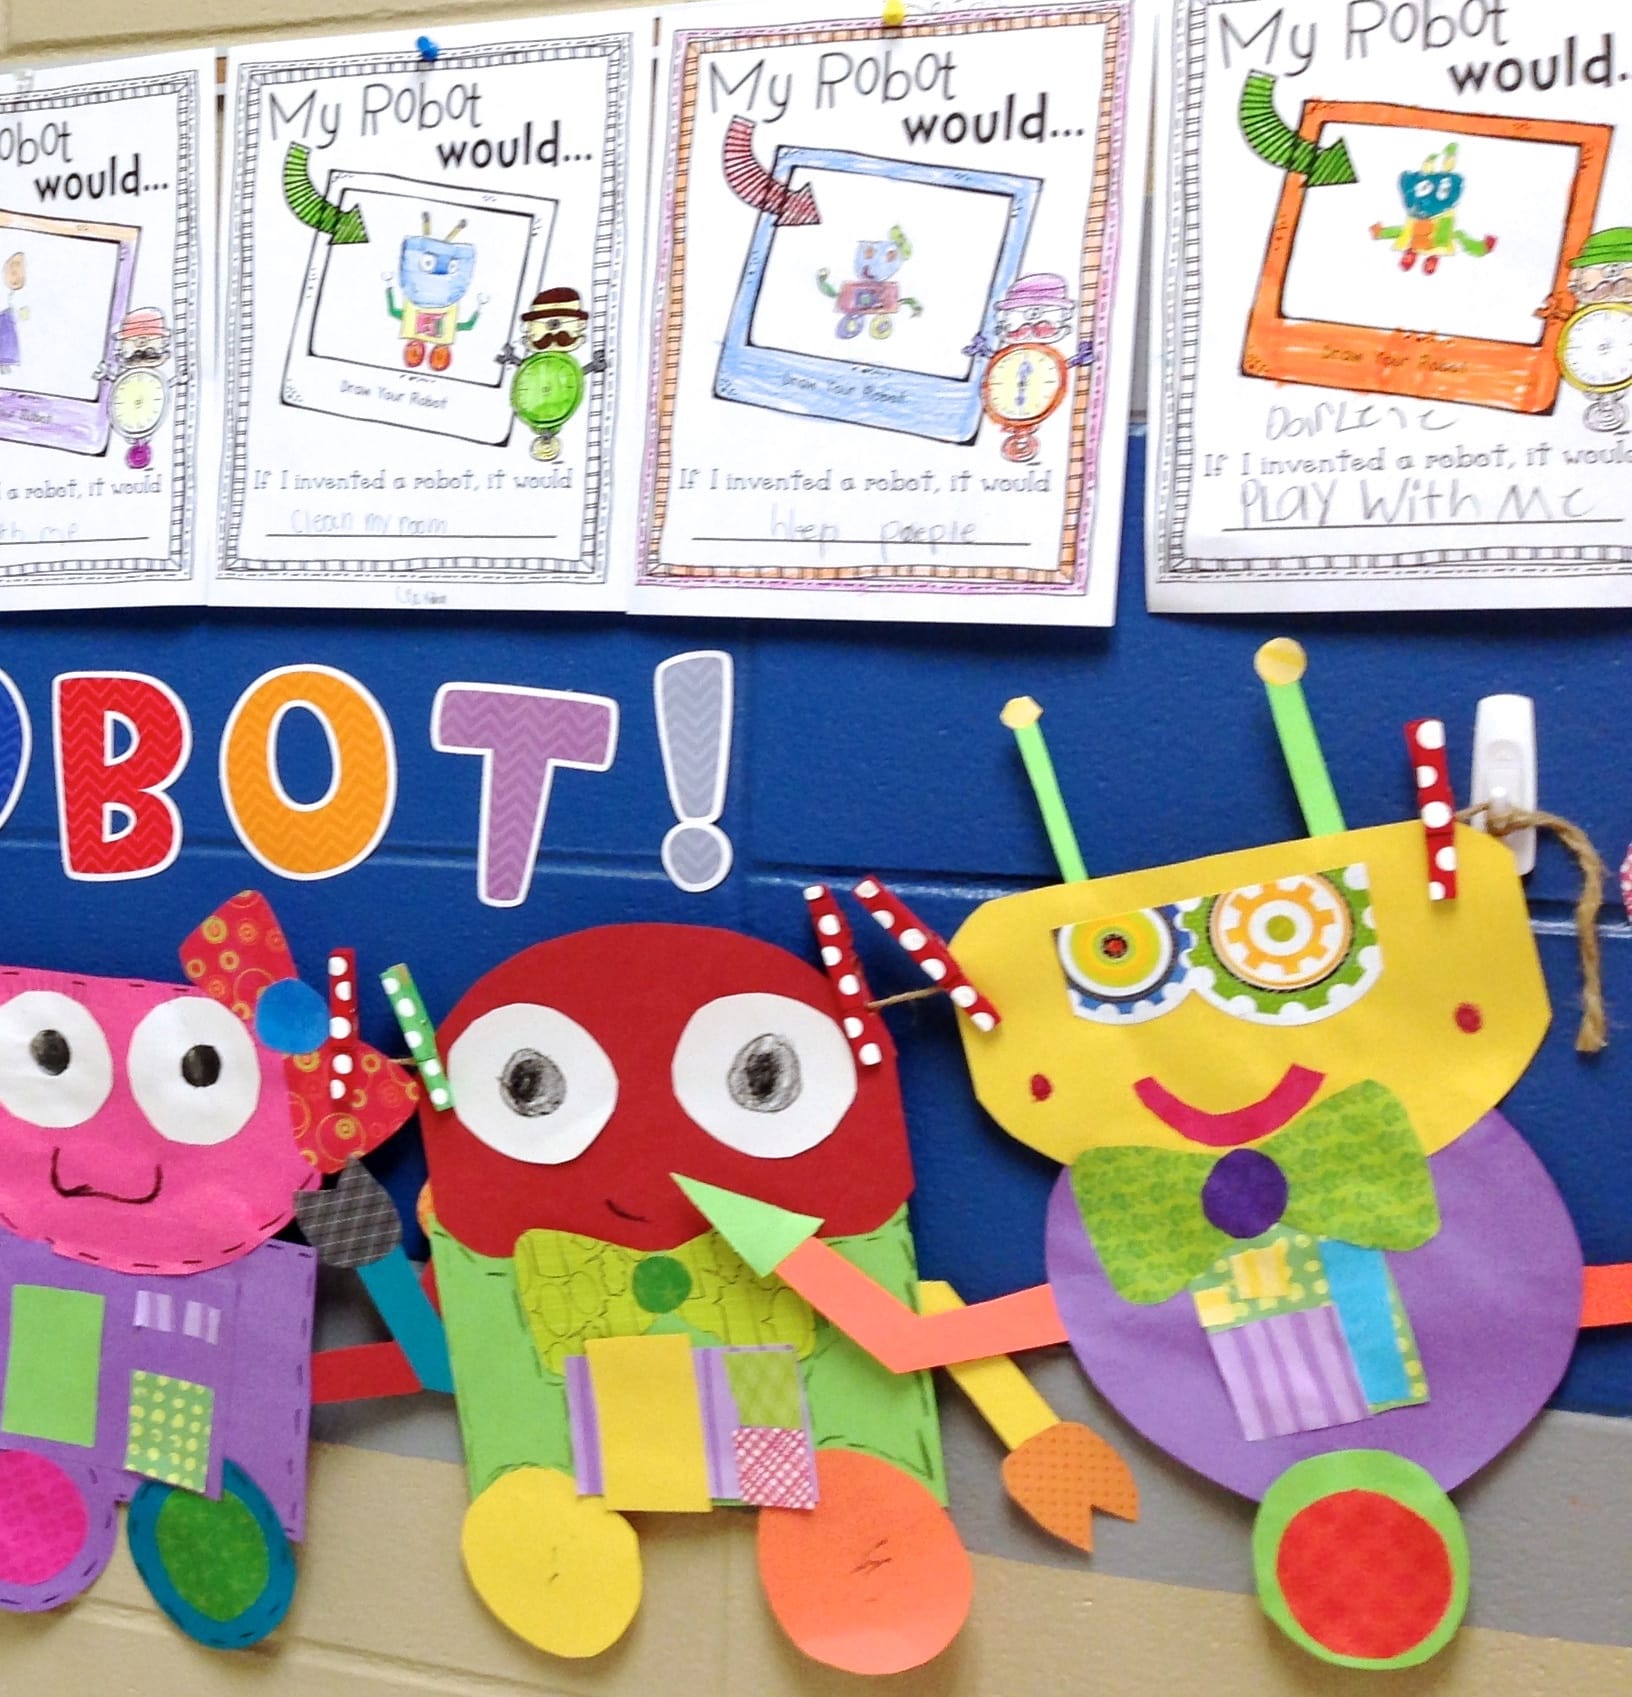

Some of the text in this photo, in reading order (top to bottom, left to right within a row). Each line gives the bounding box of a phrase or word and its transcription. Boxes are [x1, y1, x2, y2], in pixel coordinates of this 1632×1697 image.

[1218, 0, 1508, 77] My Robot
[709, 51, 957, 124] My Robot
[269, 81, 483, 150] My Robot
[902, 91, 1085, 147] would...
[436, 119, 594, 170] would...
[33, 152, 168, 202] would...
[340, 380, 448, 409] Draw Your Robot
[254, 467, 573, 492] If I invented a robot, it would
[678, 468, 1053, 494] If I invented a robot, it would
[1204, 453, 1228, 476] If
[1241, 452, 1251, 476] I
[1260, 447, 1387, 476] invented
[1396, 454, 1415, 470] a
[1425, 444, 1516, 471] robot,
[1526, 442, 1552, 466] it
[7, 488, 20, 500] a
[25, 479, 83, 499] robot,
[88, 477, 105, 496] it
[111, 473, 163, 494] would
